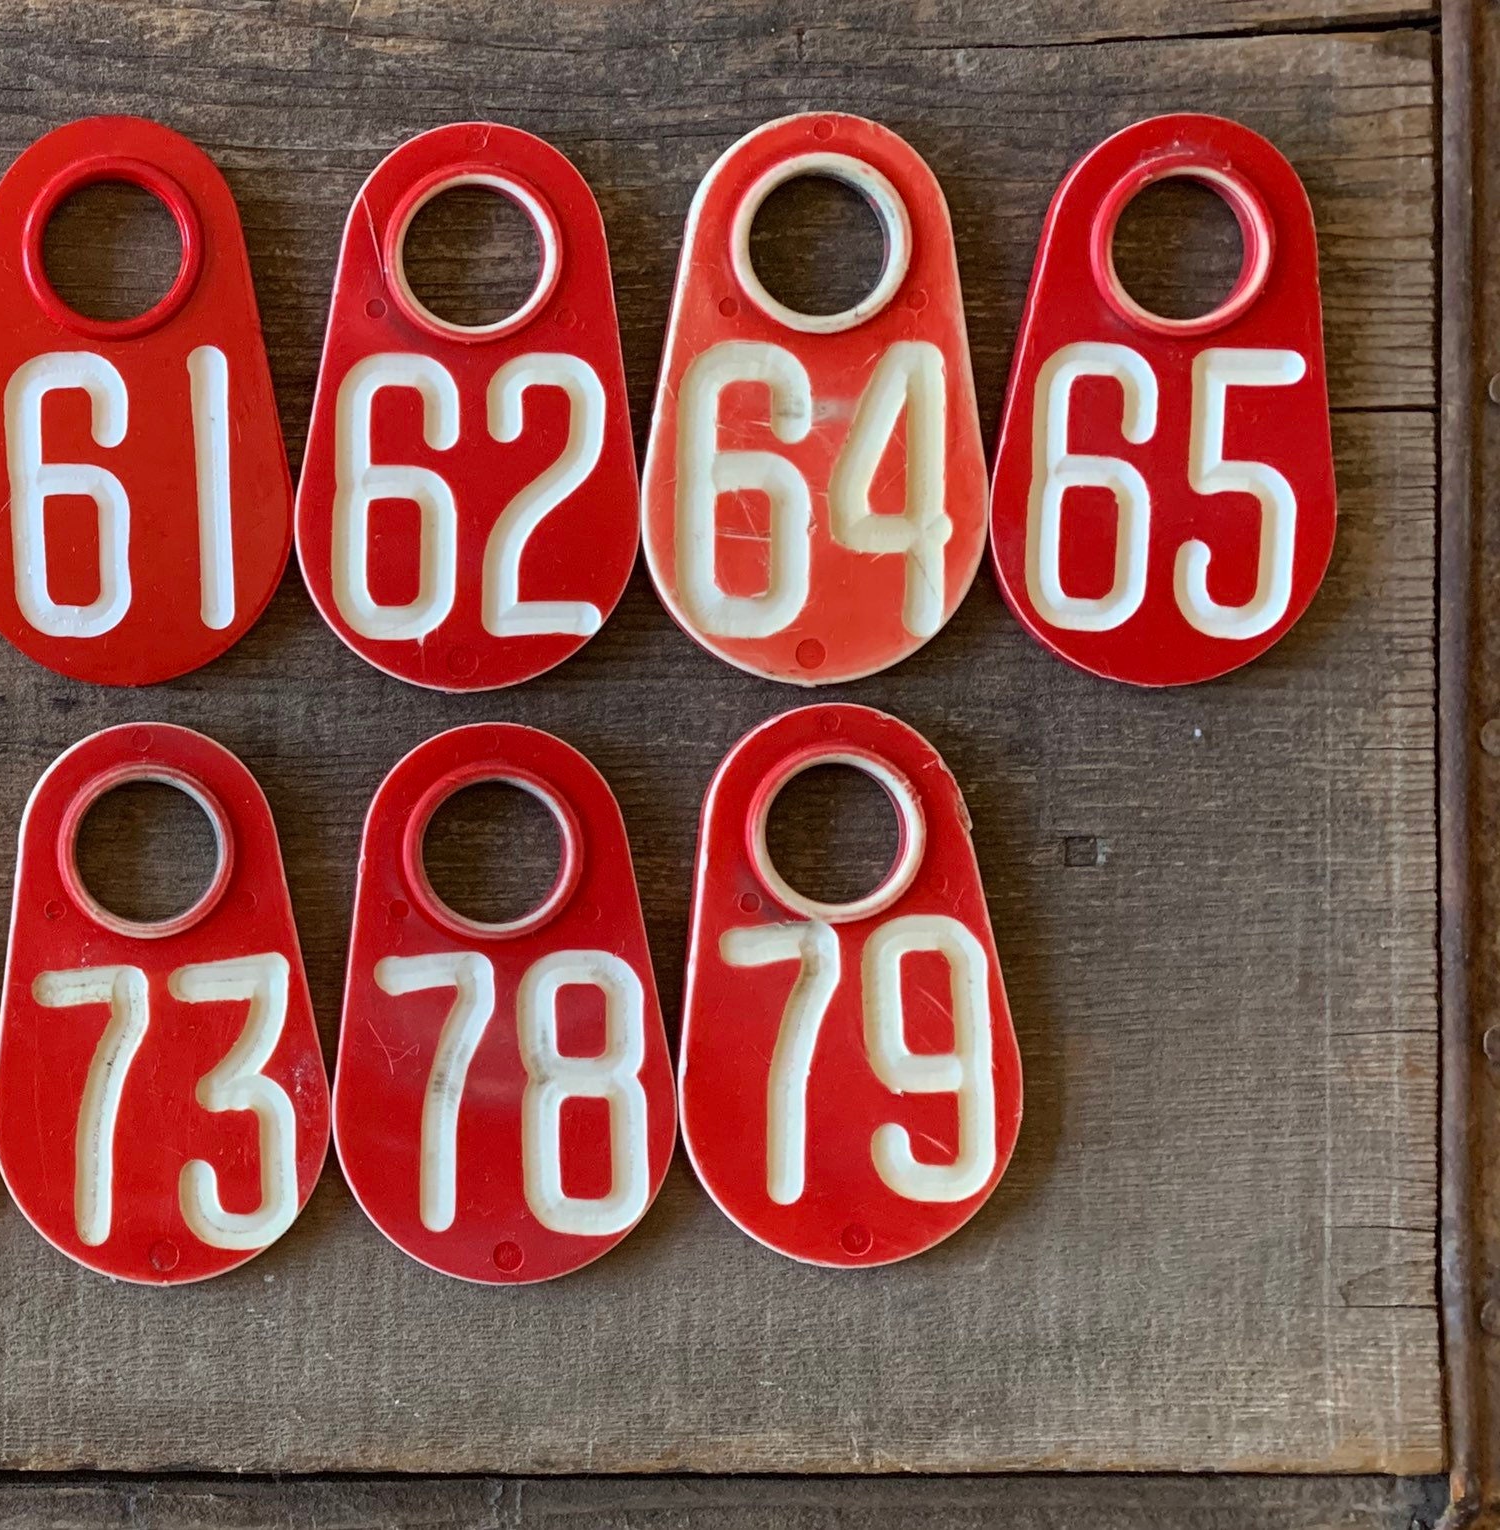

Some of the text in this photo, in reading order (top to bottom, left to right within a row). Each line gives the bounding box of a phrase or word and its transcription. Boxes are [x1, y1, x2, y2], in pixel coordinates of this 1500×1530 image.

[3, 345, 235, 638] 61
[332, 352, 606, 641] 62
[675, 341, 953, 638] 64
[1025, 342, 1306, 640] 65
[31, 952, 298, 1250] 73
[374, 949, 649, 1236] 78
[719, 914, 996, 1206] 79
